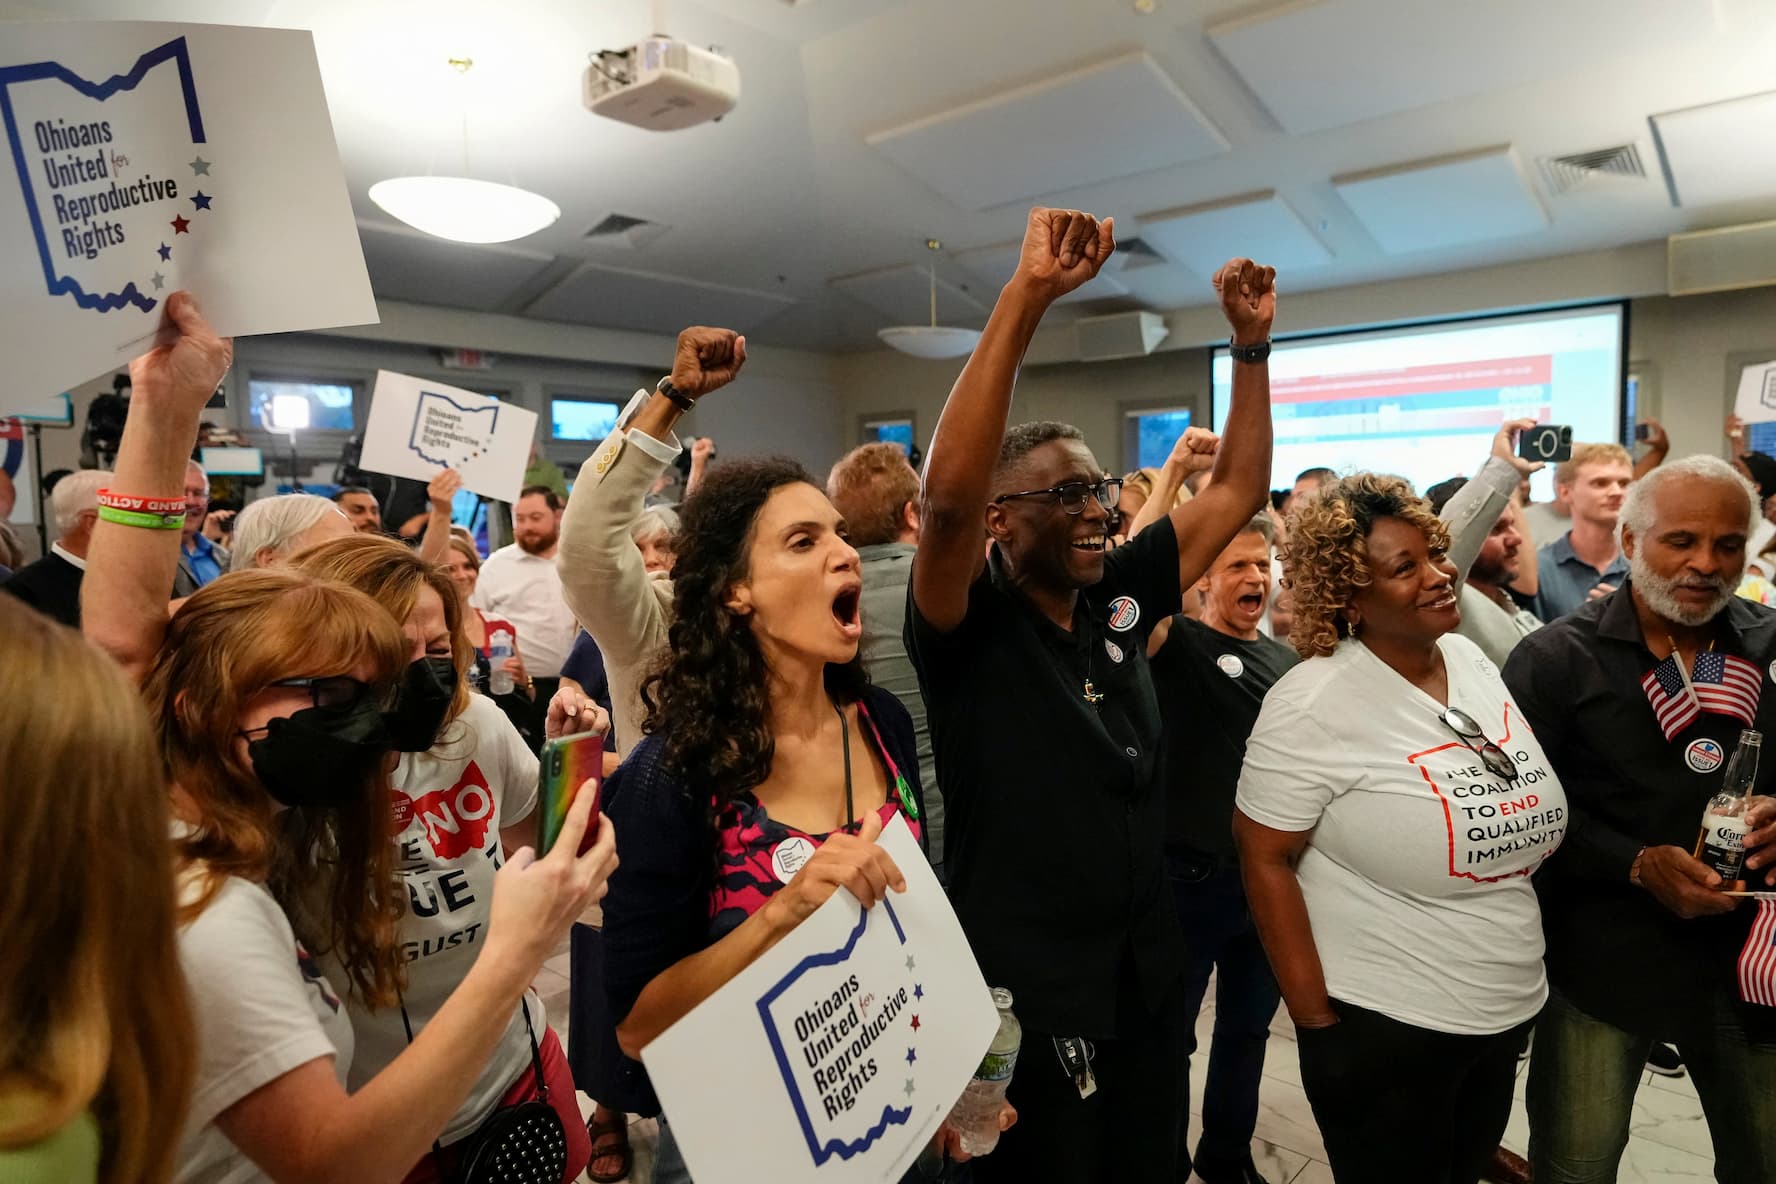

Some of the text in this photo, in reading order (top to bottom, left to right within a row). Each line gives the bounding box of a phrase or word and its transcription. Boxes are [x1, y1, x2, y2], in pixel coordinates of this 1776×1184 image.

[34, 118, 113, 154] Ohioans
[43, 149, 129, 189] United for
[52, 174, 178, 226] Reproductive
[62, 221, 125, 260] Rights
[423, 784, 491, 845] NO
[1462, 794, 1540, 820] TO END
[1467, 807, 1564, 842] QUALIFIED
[1467, 828, 1565, 864] IMMUNITY
[401, 922, 482, 964] GUST
[794, 974, 860, 1043] Ohioans
[803, 992, 875, 1068] United for
[813, 986, 908, 1097] Reproductive
[822, 1058, 878, 1122] Rights
